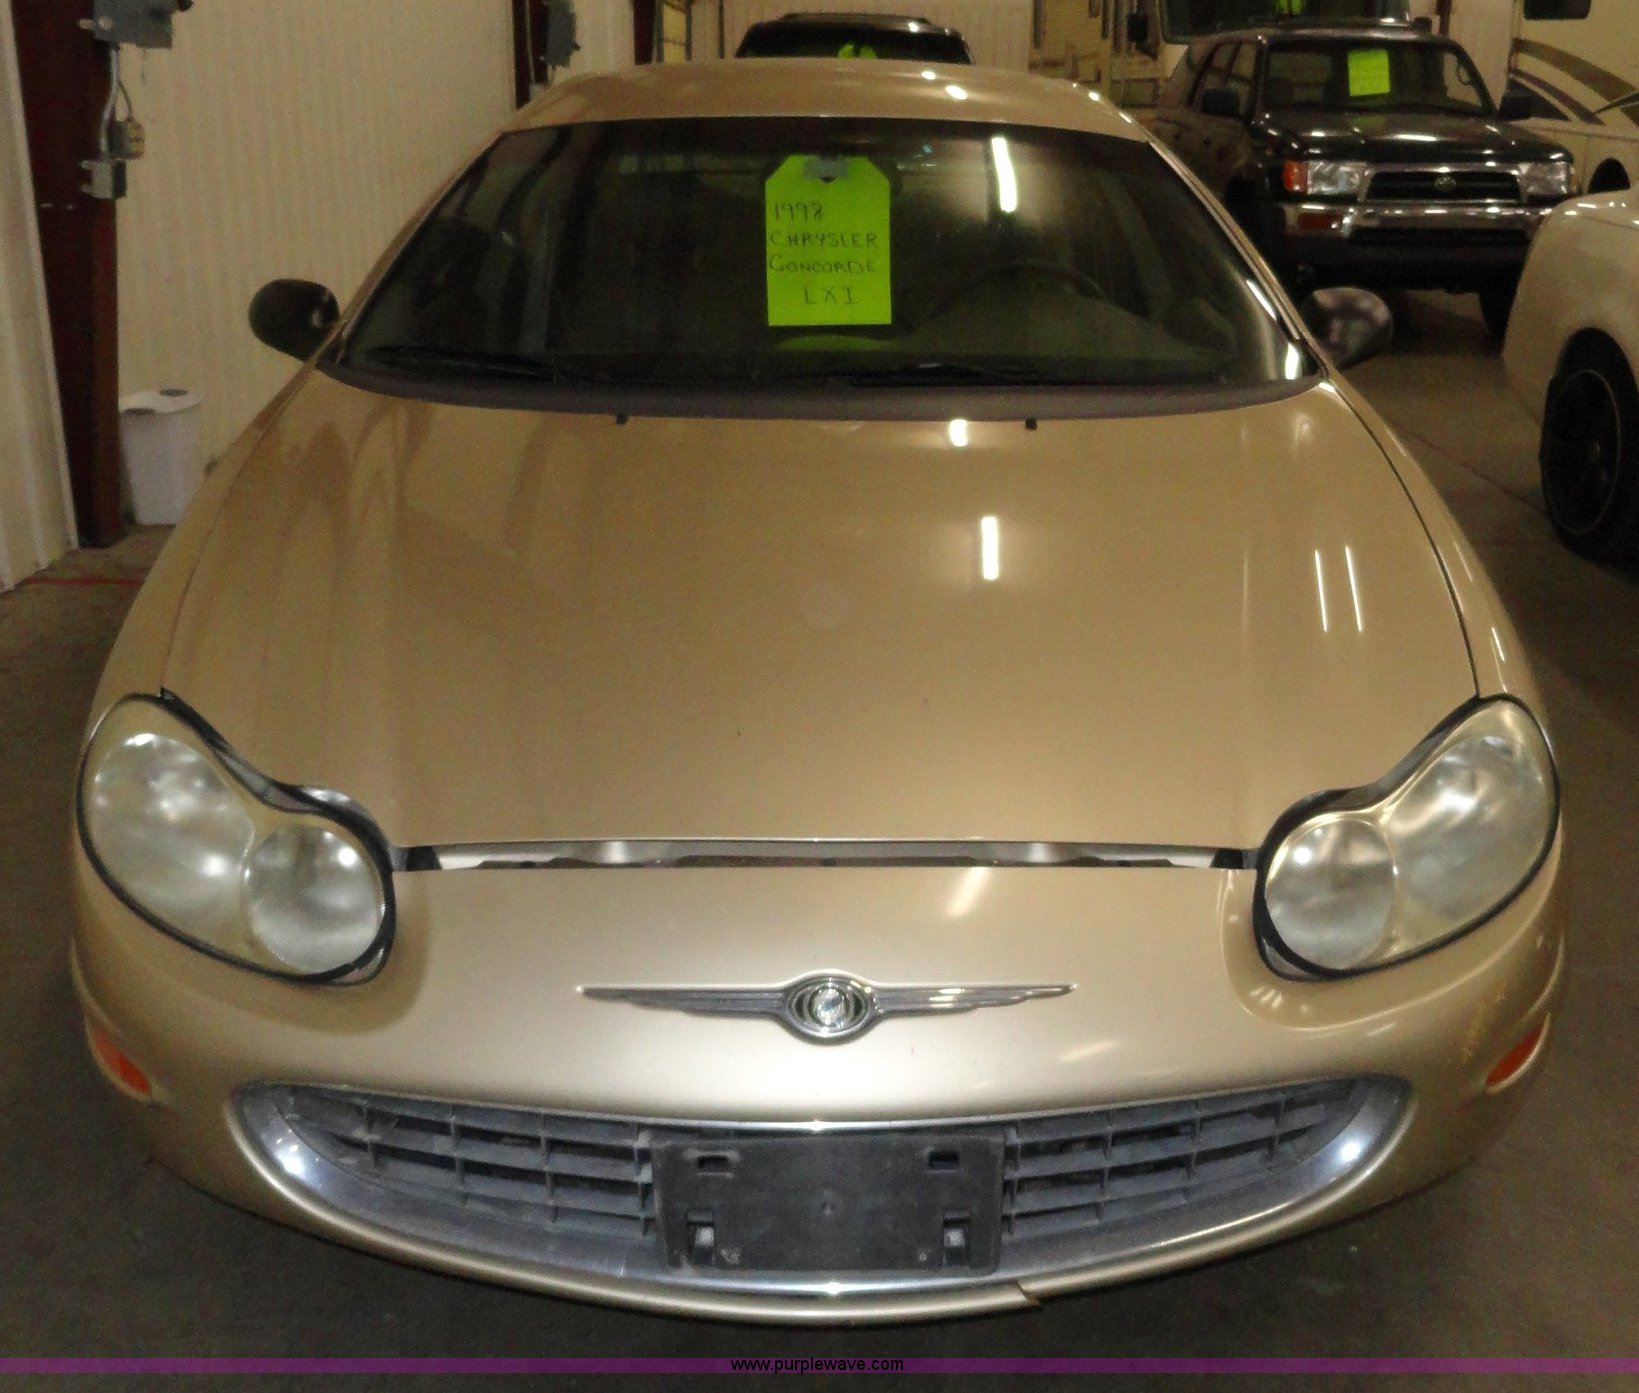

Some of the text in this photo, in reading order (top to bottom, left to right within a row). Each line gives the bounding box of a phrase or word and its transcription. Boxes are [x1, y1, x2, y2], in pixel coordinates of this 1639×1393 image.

[774, 202, 823, 222] 1998
[769, 231, 879, 248] CHRYSLER
[768, 254, 878, 275] CONCORDE
[804, 286, 858, 305] LXI
